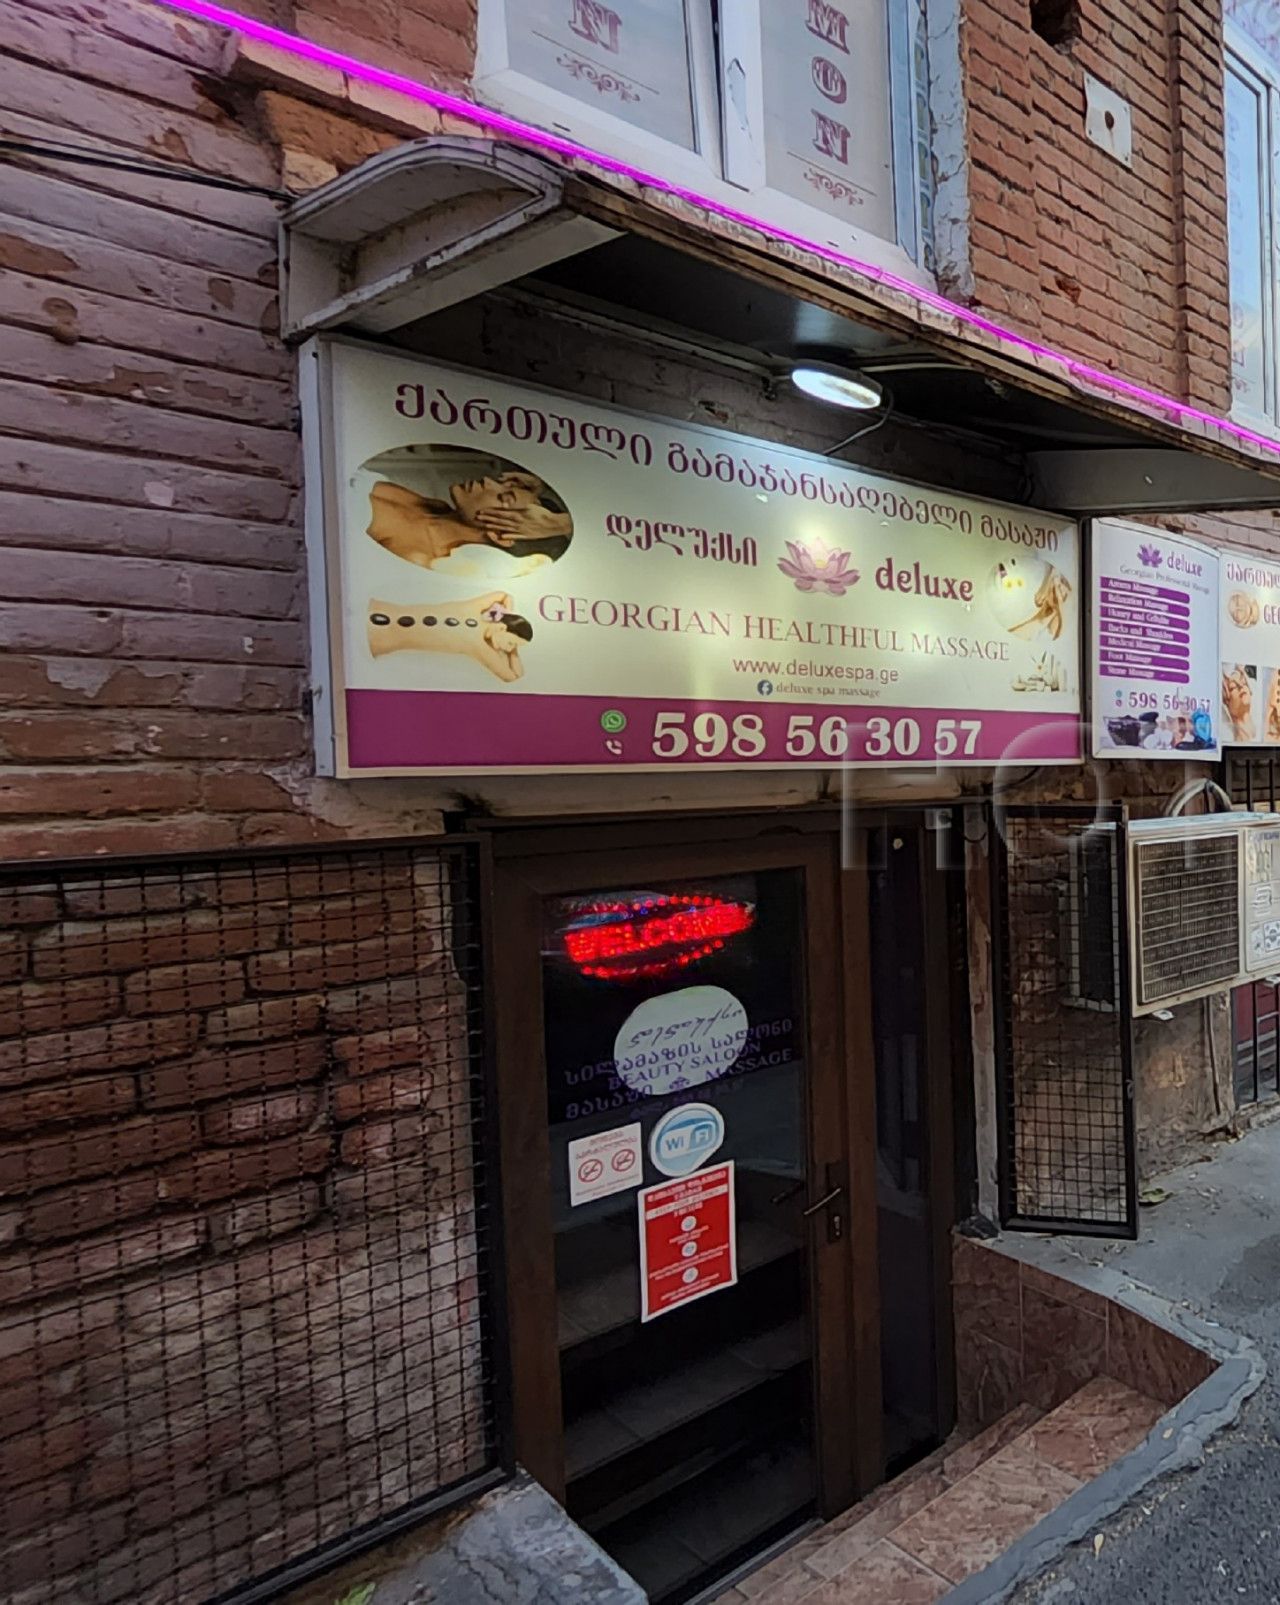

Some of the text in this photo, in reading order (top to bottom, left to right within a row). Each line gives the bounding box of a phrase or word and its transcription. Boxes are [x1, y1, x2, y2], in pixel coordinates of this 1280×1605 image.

[395, 383, 1059, 552] ქართული გამაჯანსაღებელი მასაჟი
[606, 512, 758, 567] დელუქსი
[876, 557, 974, 602] deluxe
[1166, 552, 1203, 577] deluxe
[538, 594, 1010, 662] GEORGIAN HEALTHFUL MASSAGE
[733, 658, 899, 684] www.deluxespa.ge
[776, 681, 881, 699] deluxe spa massage
[1129, 691, 1158, 709] 598
[651, 712, 982, 759] 598 56 30 57
[564, 1018, 793, 1086] სილამაზის სალონი
[608, 1040, 761, 1092] BEAUTY SALOON
[705, 1048, 793, 1080] MASSAGE
